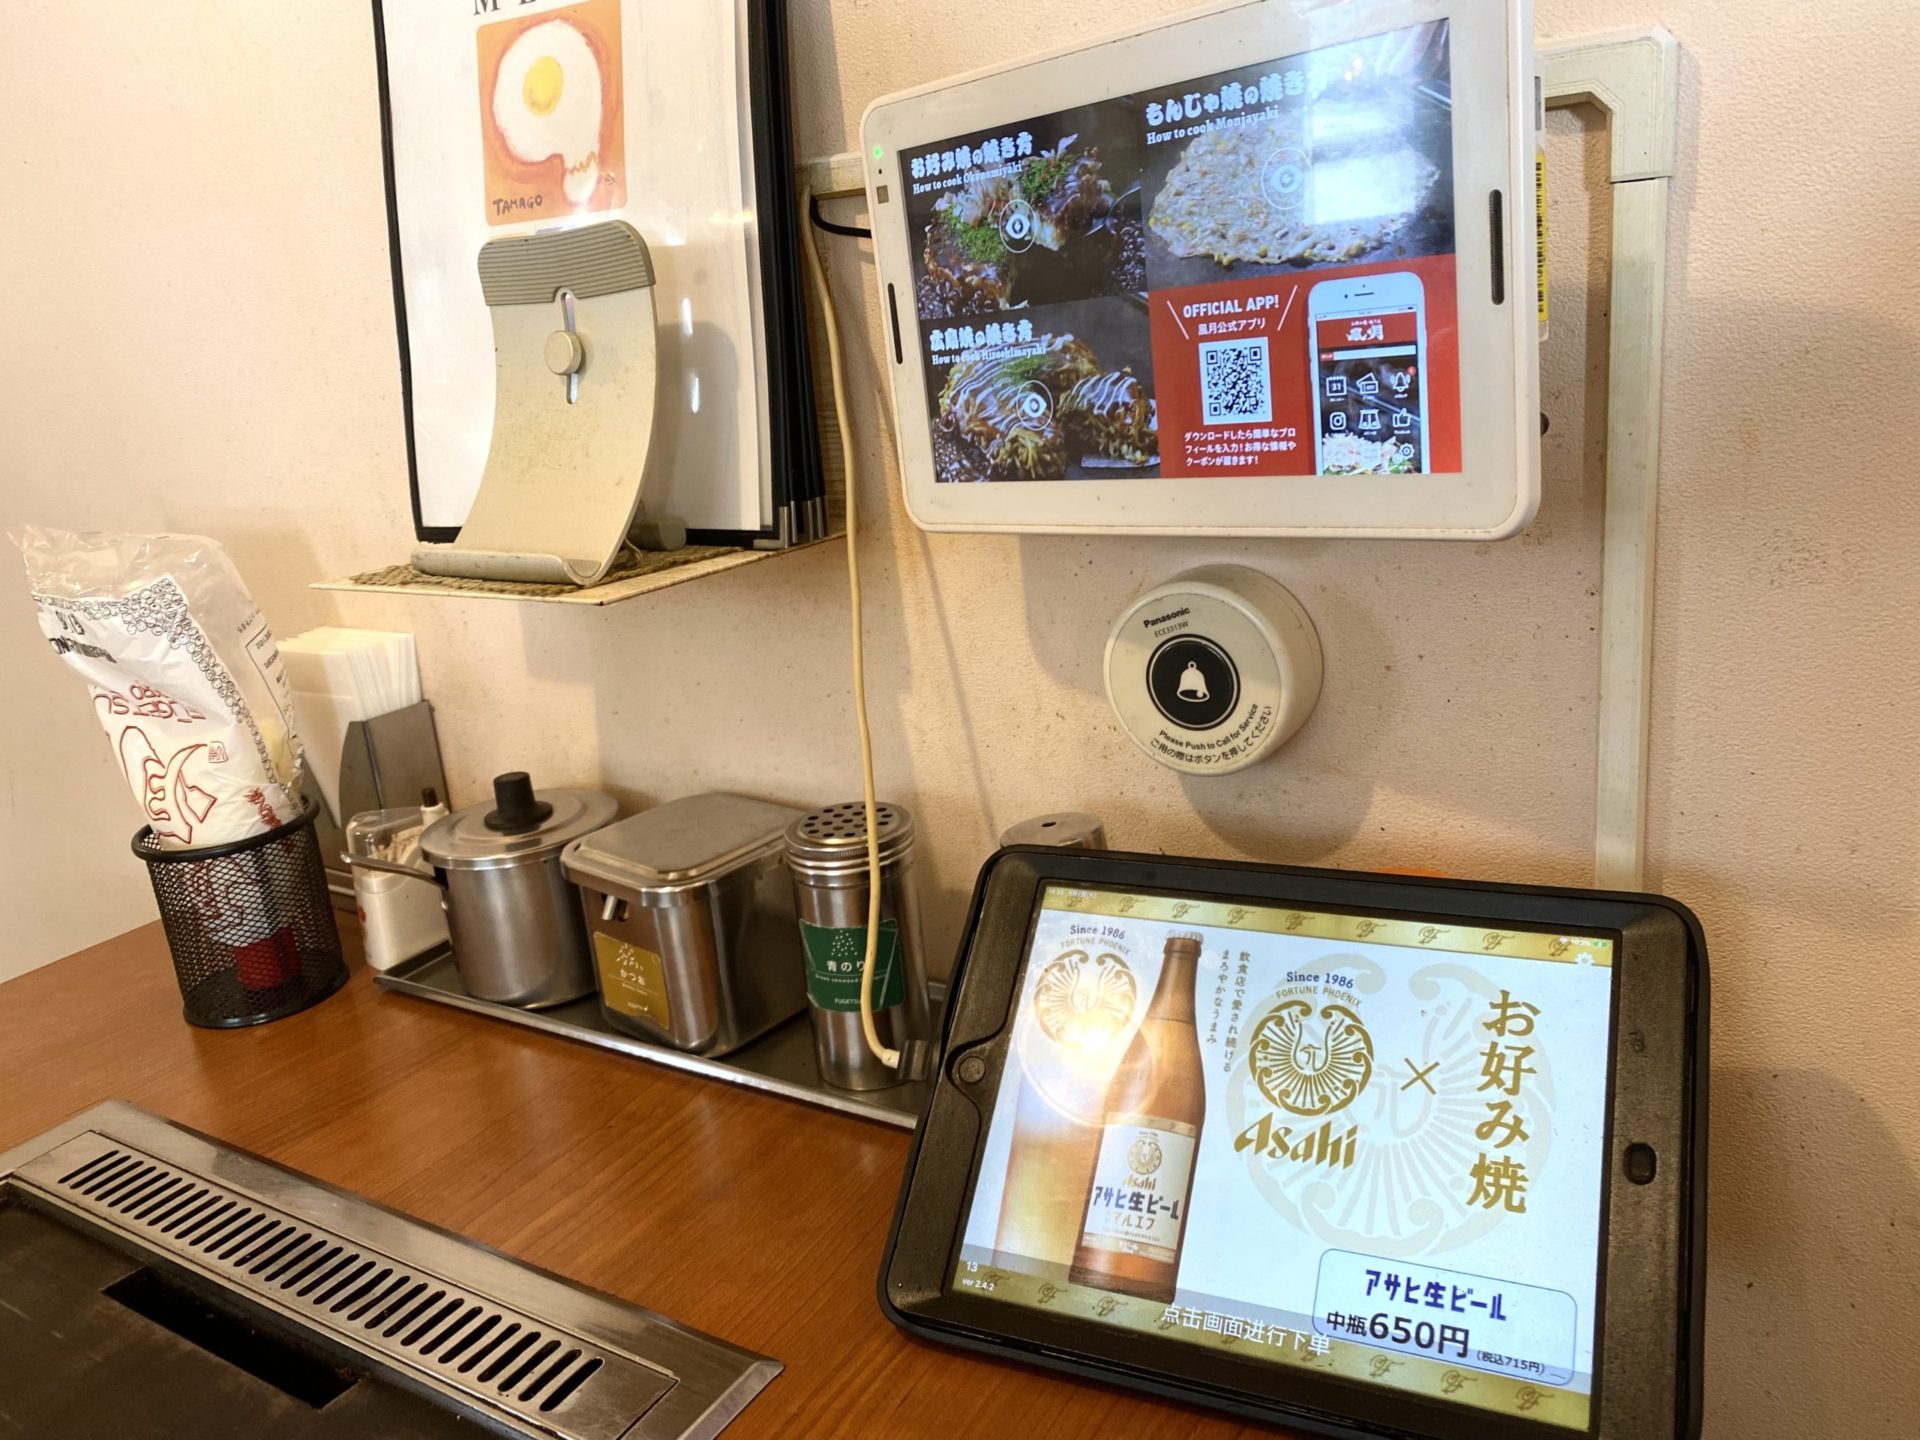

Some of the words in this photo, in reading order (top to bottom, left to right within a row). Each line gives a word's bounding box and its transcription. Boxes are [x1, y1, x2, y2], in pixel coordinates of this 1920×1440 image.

[1146, 132, 1172, 145] How
[1174, 128, 1185, 138] to
[1187, 120, 1216, 136] cook
[1216, 105, 1279, 130] Monjayaki
[912, 182, 932, 195] How
[933, 180, 942, 190] to
[943, 175, 962, 187] cook
[493, 194, 543, 215] TAMAGO
[1183, 299, 1243, 318] OFFICIAL
[1246, 294, 1280, 312] APP!
[1198, 317, 1266, 336] 風月公式アプリ
[931, 355, 951, 366] How
[951, 354, 960, 363] to
[1143, 606, 1190, 628] Panasonic
[1159, 730, 1184, 747] Please
[1185, 741, 1206, 750] Push
[1207, 742, 1216, 750] to
[1216, 736, 1231, 747] Call
[1230, 729, 1241, 740] for
[1239, 703, 1258, 732] Service
[1060, 937, 1095, 949] FORTUNE
[1070, 925, 1098, 935] Since
[1101, 925, 1126, 940] 1986
[827, 960, 865, 973] 青のり
[1286, 971, 1320, 983] Since
[1324, 972, 1354, 989] 1986
[1206, 949, 1230, 1045] まろやかなうまみ
[1276, 985, 1319, 1000] FORTUNE
[1322, 986, 1363, 1008] PHOENIX
[1466, 989, 1542, 1214] お好み焼
[1233, 1112, 1359, 1169] Asahi
[1093, 1186, 1179, 1220] アサヒ生ビール
[966, 1261, 978, 1272] 13
[962, 1278, 974, 1287] ver
[975, 1280, 994, 1291] 2.4.2
[1364, 1269, 1507, 1322] アサヒ生ビール
[1160, 1302, 1331, 1357] 点击画面进行下单
[1326, 1310, 1470, 1359] 中瓶650円
[1476, 1349, 1546, 1375] (税込715円)
